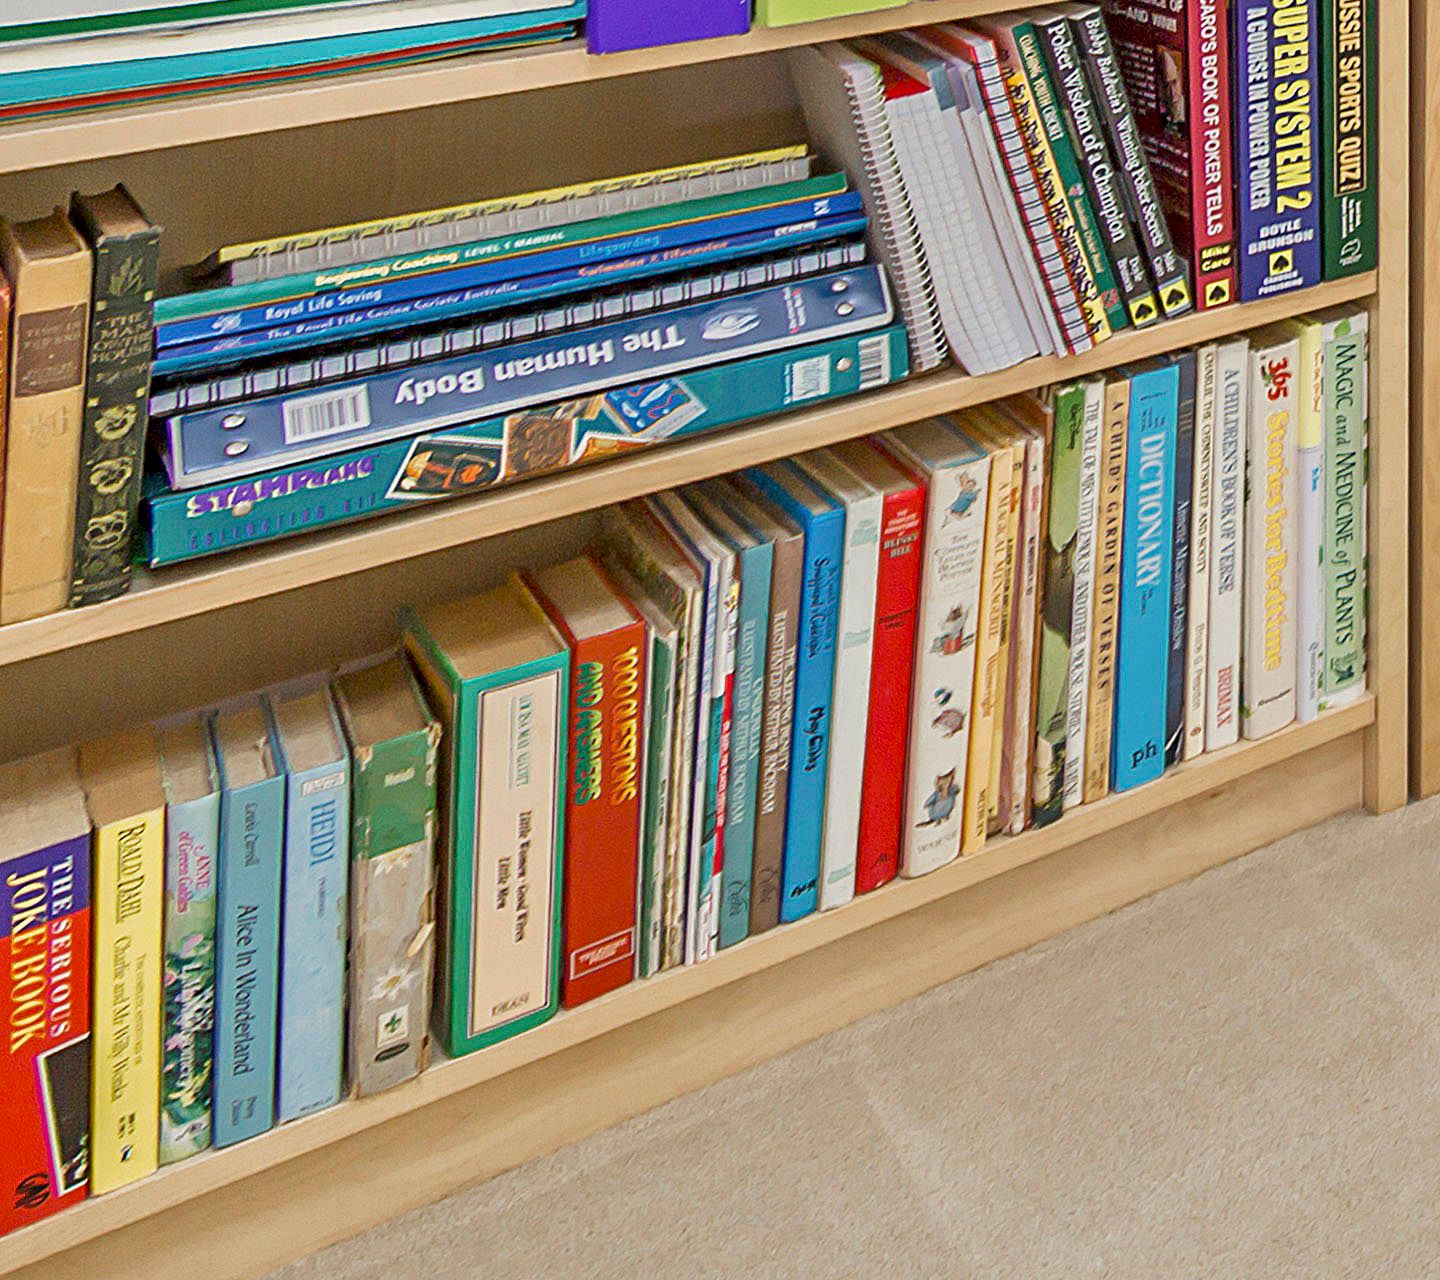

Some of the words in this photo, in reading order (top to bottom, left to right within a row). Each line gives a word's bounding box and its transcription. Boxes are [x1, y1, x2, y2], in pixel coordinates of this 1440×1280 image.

[1201, 56, 1219, 98] BOOK
[1339, 56, 1361, 132] SPORTS
[1203, 102, 1219, 123] OF
[1274, 79, 1312, 189] SYSTEM
[1204, 125, 1221, 185] POKER
[1206, 190, 1224, 237] TELLS
[1276, 190, 1312, 214] 2
[494, 341, 616, 381] Human
[623, 324, 686, 352] The
[394, 368, 486, 406] Body
[1267, 410, 1290, 510] Stories
[1135, 432, 1167, 588] DICTIONARY
[1267, 510, 1288, 551] for
[1264, 550, 1288, 671] Bedtime
[6, 866, 49, 955] JOKE
[9, 953, 47, 1054] BOOK
